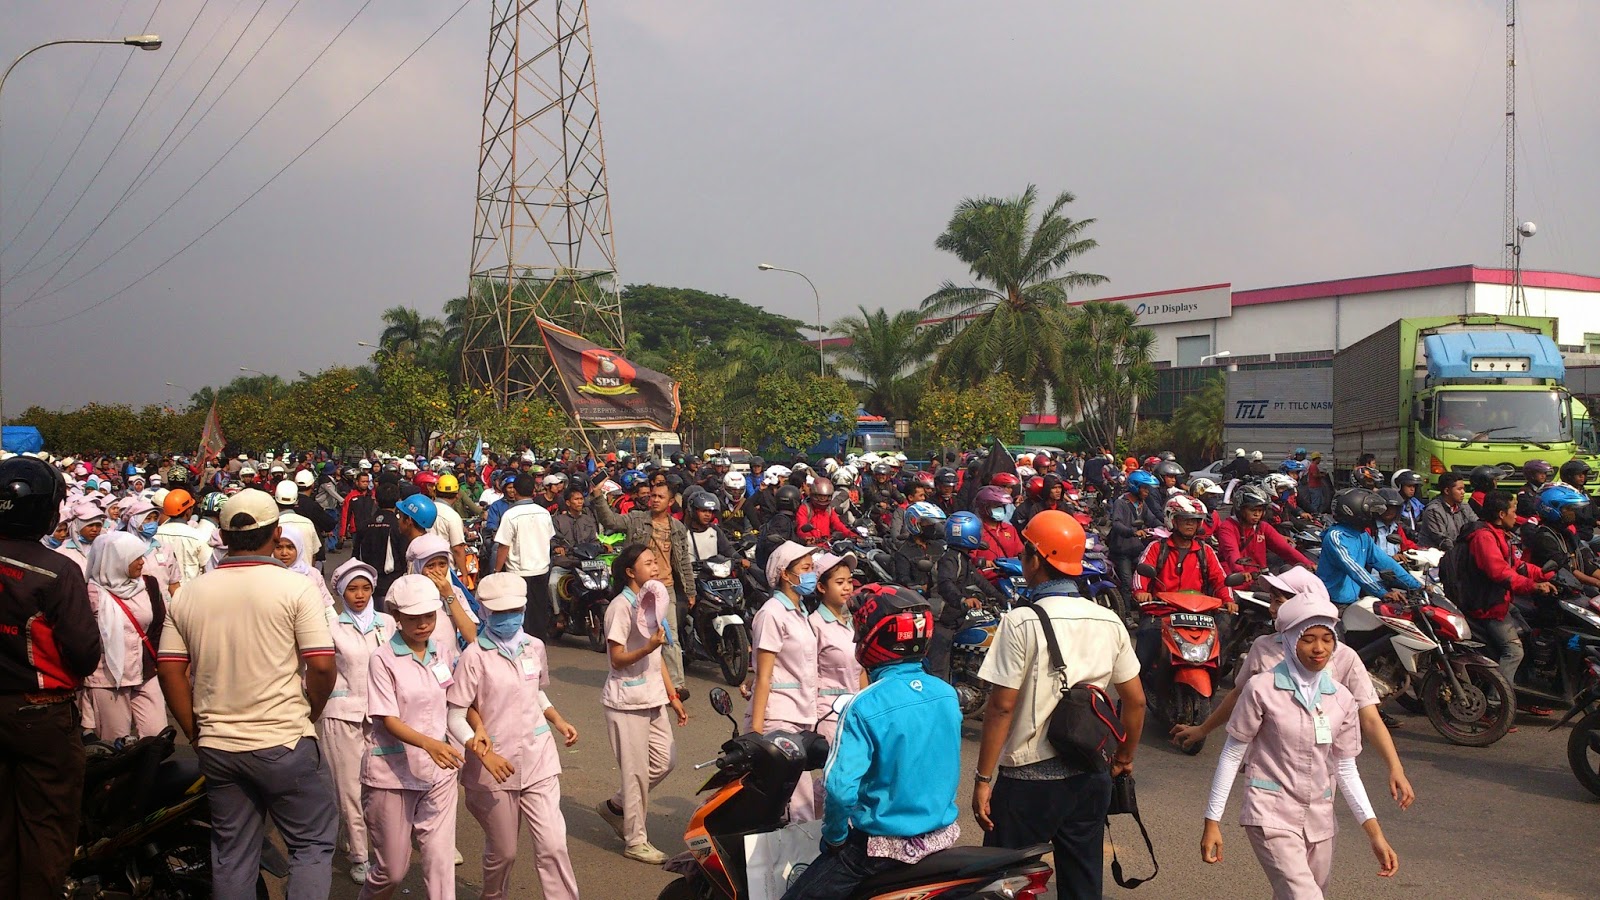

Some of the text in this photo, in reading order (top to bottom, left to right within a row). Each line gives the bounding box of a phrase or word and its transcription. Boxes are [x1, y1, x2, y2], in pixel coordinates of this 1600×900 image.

[1147, 302, 1198, 315] LP Displays
[596, 377, 621, 386] SPSI
[1235, 400, 1270, 419] TTLC
[1274, 402, 1287, 410] PT.
[1289, 402, 1309, 410] TTLC
